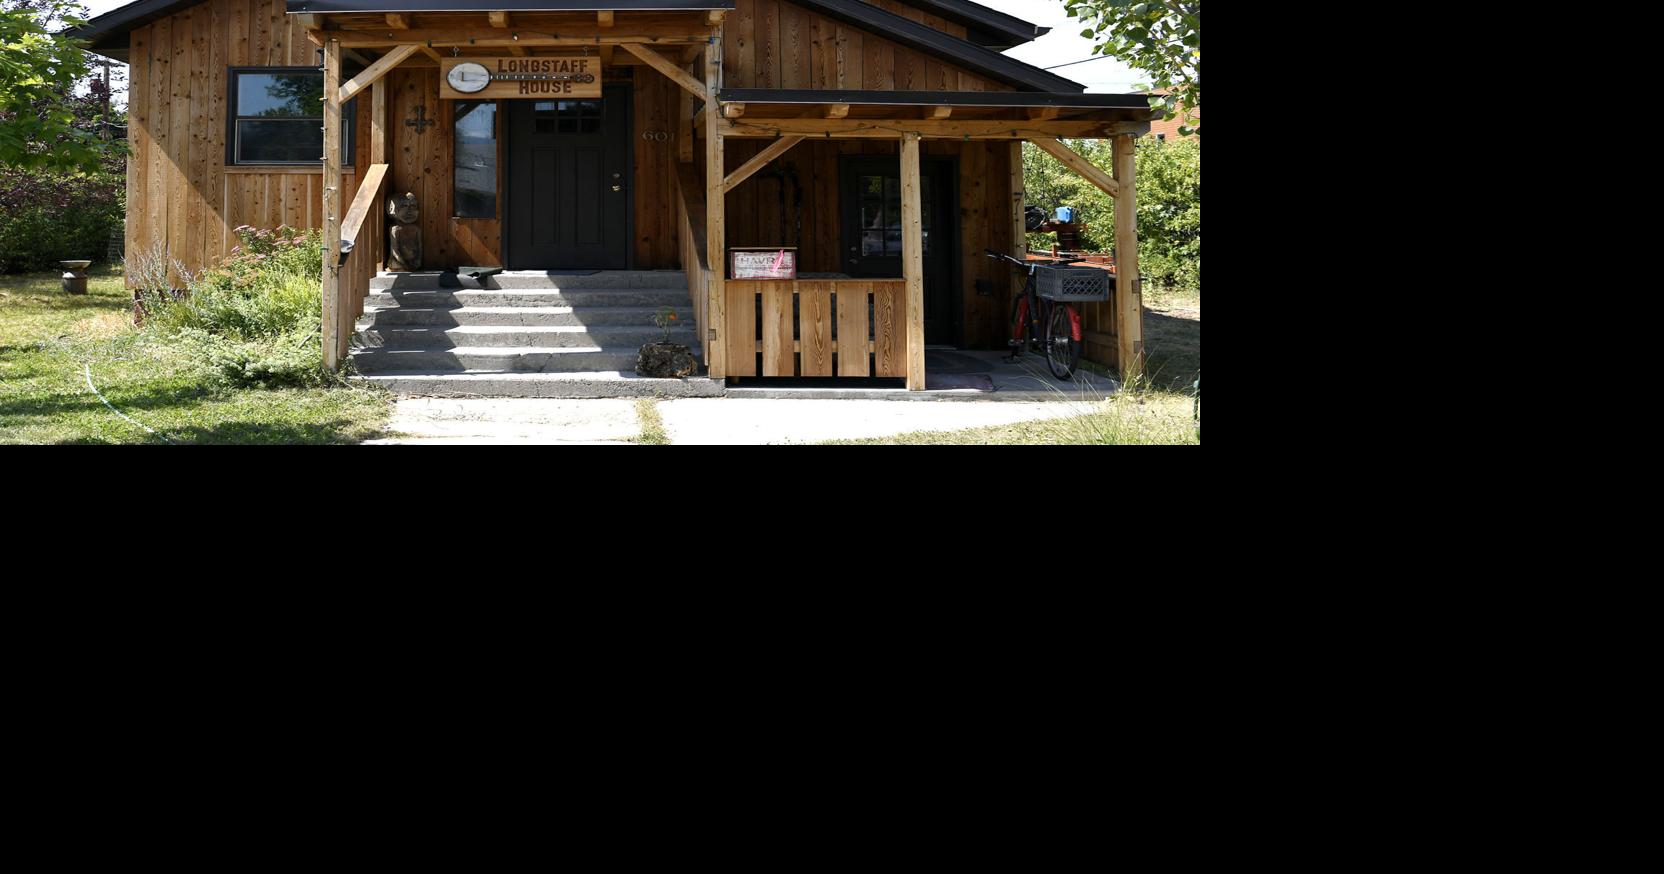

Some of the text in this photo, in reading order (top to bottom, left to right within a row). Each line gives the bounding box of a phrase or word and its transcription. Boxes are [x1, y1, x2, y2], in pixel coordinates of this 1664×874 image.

[497, 59, 588, 73] LONGSTAFF
[518, 80, 572, 94] HOUSE
[740, 257, 784, 265] HAVR
